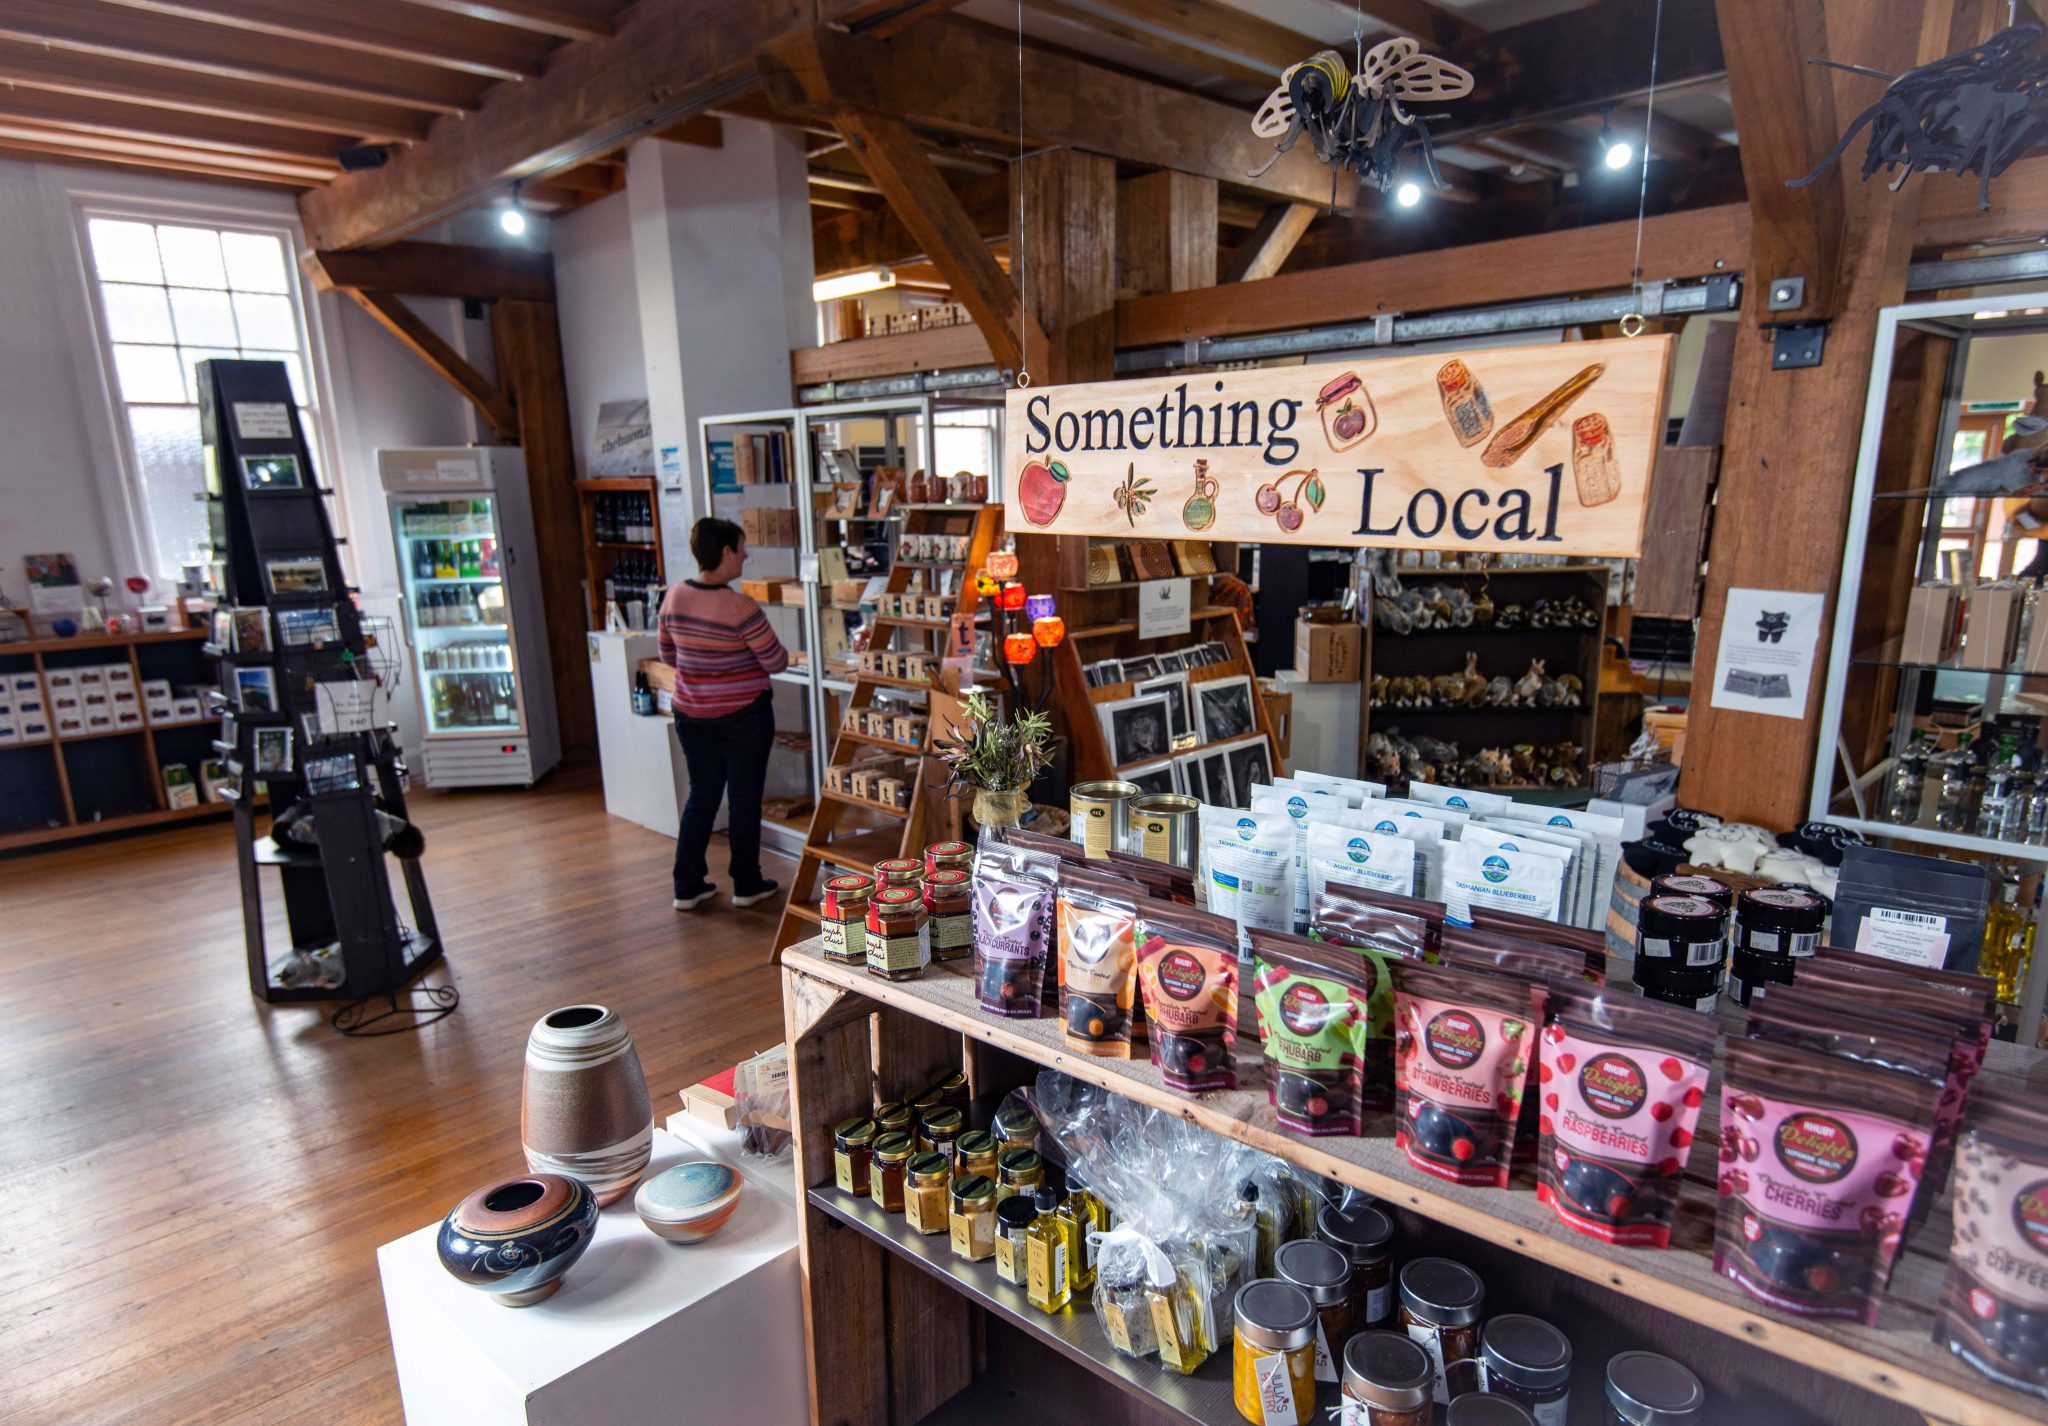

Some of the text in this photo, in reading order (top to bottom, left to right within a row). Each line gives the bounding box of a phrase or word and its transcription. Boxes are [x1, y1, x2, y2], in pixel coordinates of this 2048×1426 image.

[1025, 380, 1303, 466] Something
[1352, 462, 1564, 542] Local
[958, 621, 970, 646] t
[1357, 868, 1393, 880] BLUEBERRIES
[1456, 881, 1537, 901] TASMANIAN BLUEBERRIES
[978, 933, 1030, 956] BLACKCURRANTS
[1161, 962, 1204, 982] Delights
[1159, 1005, 1199, 1024] RHUBARB
[1430, 1023, 1484, 1049] Delights
[1279, 1039, 1321, 1063] RHUBARB
[1412, 1067, 1491, 1104] STRAWBERRIES
[1583, 1067, 1645, 1097] Delights
[1562, 1116, 1649, 1157] RASPBERRIES
[1803, 1120, 1836, 1137] RHUBY
[1779, 1124, 1854, 1160] Delights
[1764, 1183, 1842, 1221] CHERRIES
[1985, 1250, 2048, 1289] COFFEE
